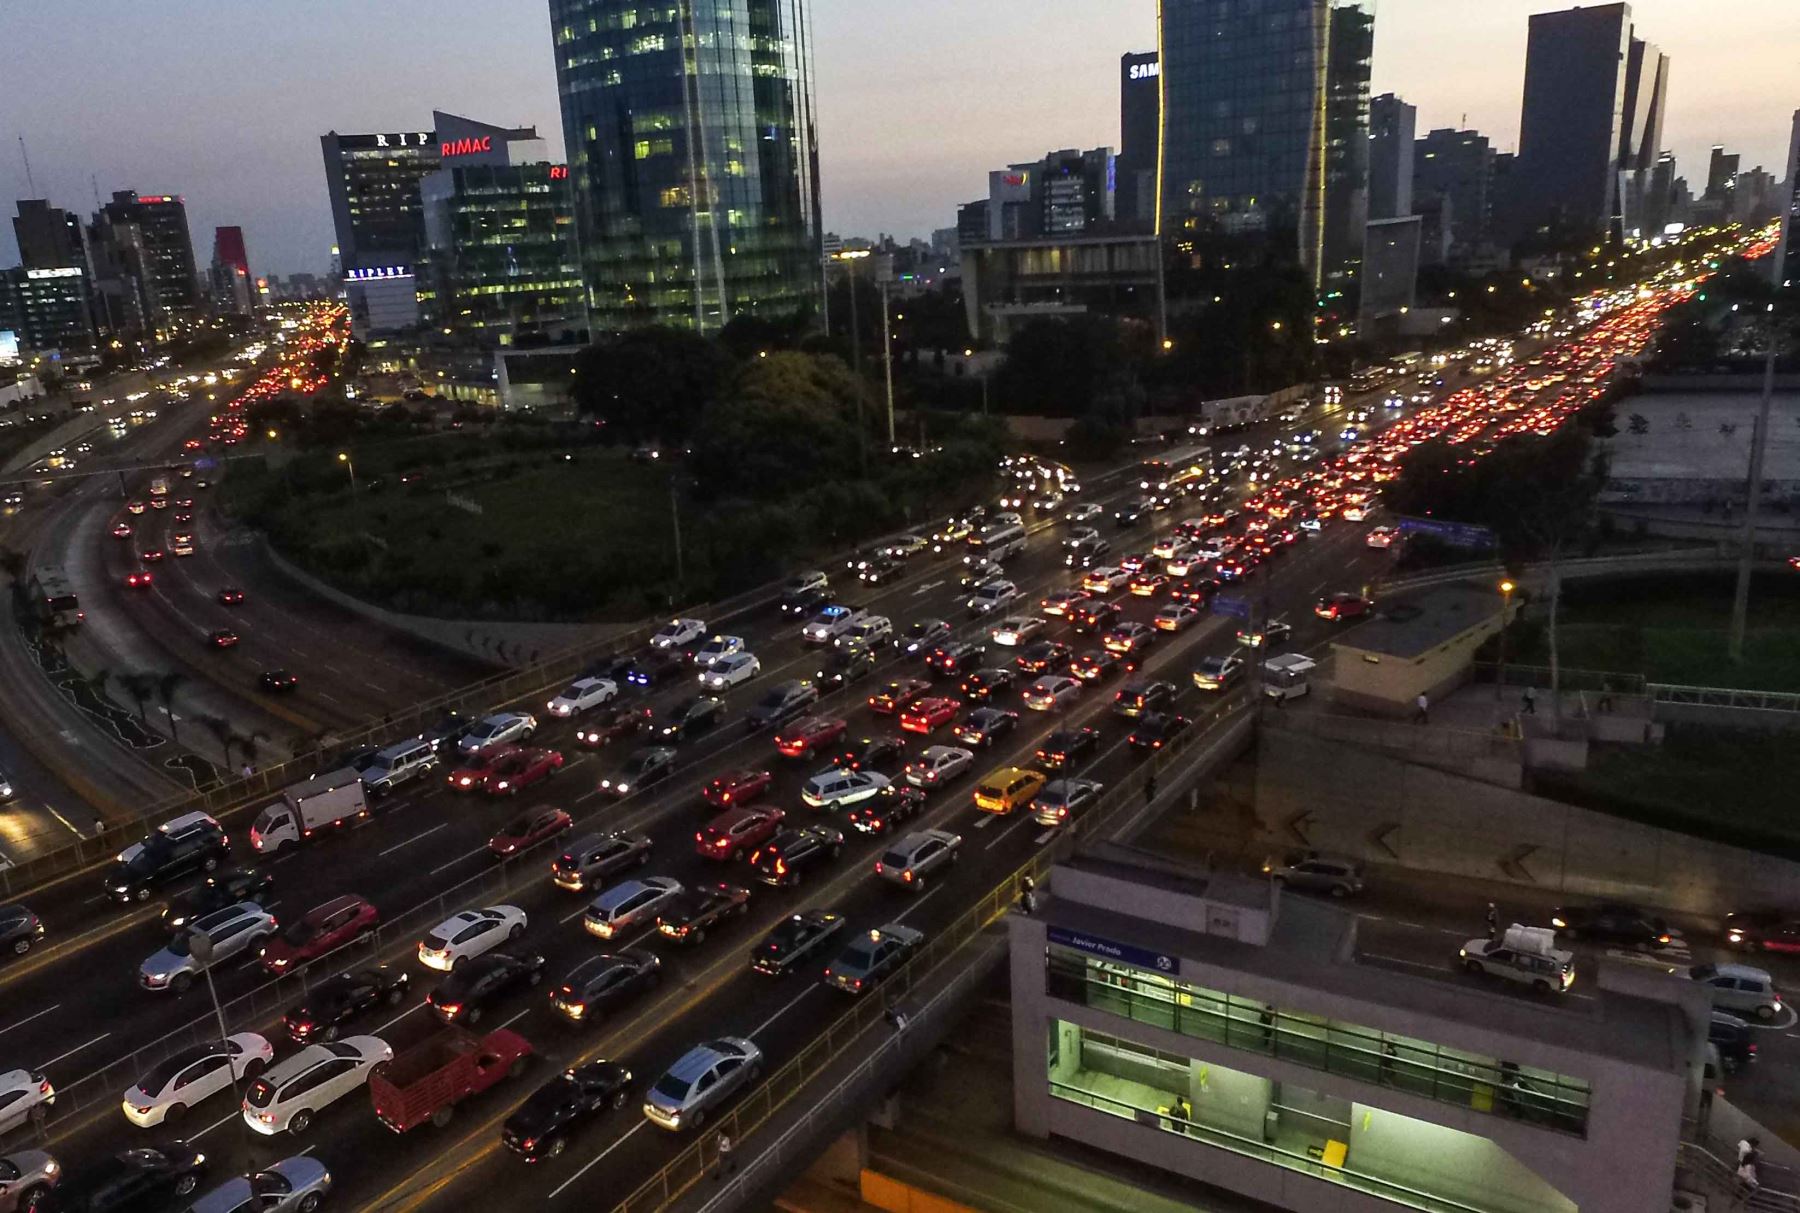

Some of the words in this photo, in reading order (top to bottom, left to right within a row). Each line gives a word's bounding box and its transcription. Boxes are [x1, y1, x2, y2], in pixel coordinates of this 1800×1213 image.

[1129, 62, 1159, 79] SAM
[441, 136, 491, 156] RIMAC
[550, 167, 567, 178] RI
[348, 266, 404, 278] RIPLEY
[1072, 936, 1097, 950] Javier
[1097, 943, 1122, 956] Prado
